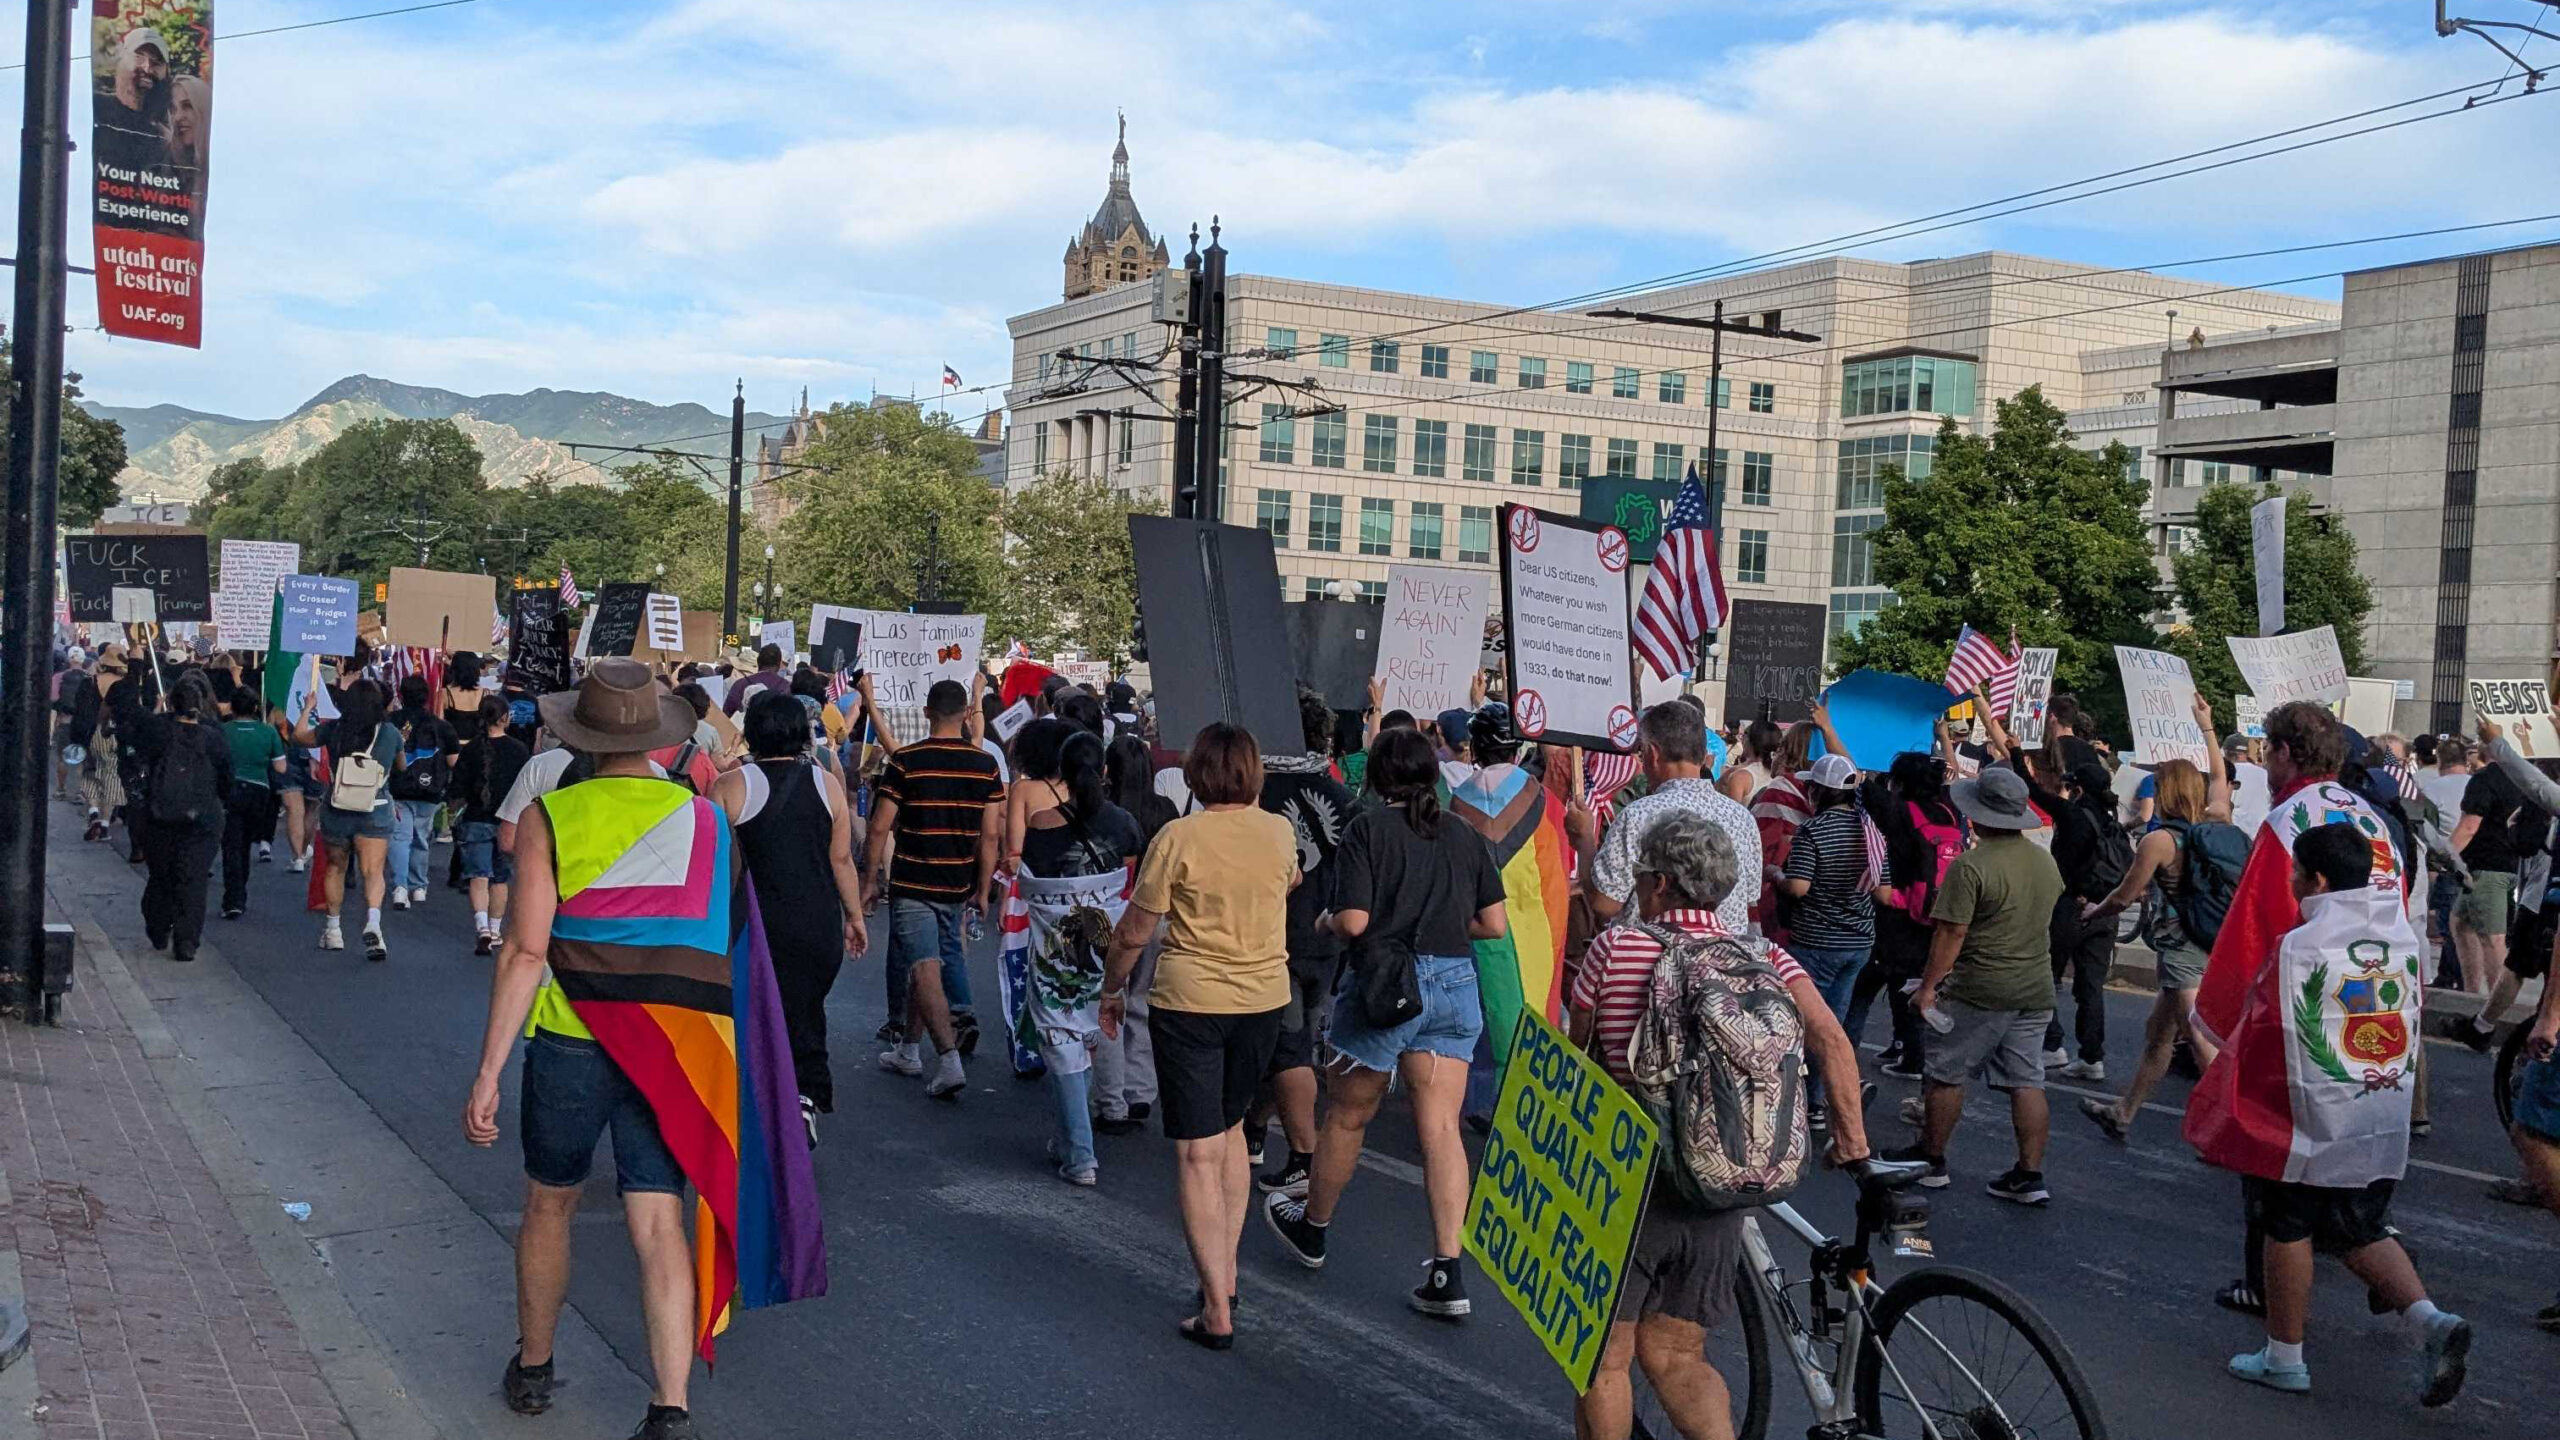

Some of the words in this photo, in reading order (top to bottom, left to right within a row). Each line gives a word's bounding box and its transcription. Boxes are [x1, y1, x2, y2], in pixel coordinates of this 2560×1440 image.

[97, 161, 137, 183] Your
[140, 170, 181, 191] Next
[98, 197, 189, 227] Experience
[102, 246, 156, 271] utah
[160, 255, 199, 277] arts
[114, 265, 191, 297] festival
[121, 303, 186, 330] UAF.org
[69, 540, 149, 567] FUCK
[291, 580, 318, 591] Every
[1519, 559, 1542, 576] Dear
[1543, 565, 1557, 580] US
[1558, 568, 1599, 589] citizens,
[70, 592, 111, 612] Fuck
[298, 594, 338, 604] Crossed
[315, 607, 347, 619] Bridges
[1519, 585, 1565, 606] Whatever
[1565, 596, 1583, 609] you
[1585, 599, 1608, 614] wish
[301, 632, 328, 641] Bones
[725, 633, 739, 645] 35
[871, 614, 908, 640] Las
[919, 619, 977, 641] familias
[1520, 612, 1546, 626] more
[1547, 616, 1585, 635] German
[1586, 623, 1624, 640] citizens
[1419, 637, 1434, 660] IS
[1521, 637, 1551, 652] would
[1552, 641, 1574, 657] have
[1575, 646, 1601, 662] done
[1603, 651, 1612, 663] in
[2297, 648, 2332, 672] THE
[1388, 656, 1450, 686] RIGHT
[1523, 661, 1550, 679] 1933,
[1551, 665, 1564, 679] do
[1566, 669, 1586, 684] that
[1587, 673, 1613, 688] now!
[2022, 650, 2041, 678] SOY
[2041, 652, 2055, 678] LA
[2120, 649, 2190, 678] AMERICA
[1753, 663, 1821, 706] KINGS
[2146, 673, 2169, 688] HAS
[2308, 666, 2347, 692] ELECT
[1397, 686, 1452, 710] NOW!
[2140, 689, 2177, 718] NO
[2470, 681, 2550, 715] RESIST
[2136, 717, 2206, 745] FUCKING
[1515, 1017, 1604, 1136] PEOPLE
[1610, 1110, 1646, 1173] OF
[1515, 1087, 1622, 1228] QUALITY
[1483, 1130, 1553, 1234] DONT
[1553, 1212, 1612, 1322] FEAR
[1473, 1197, 1594, 1365] EQUALITY
